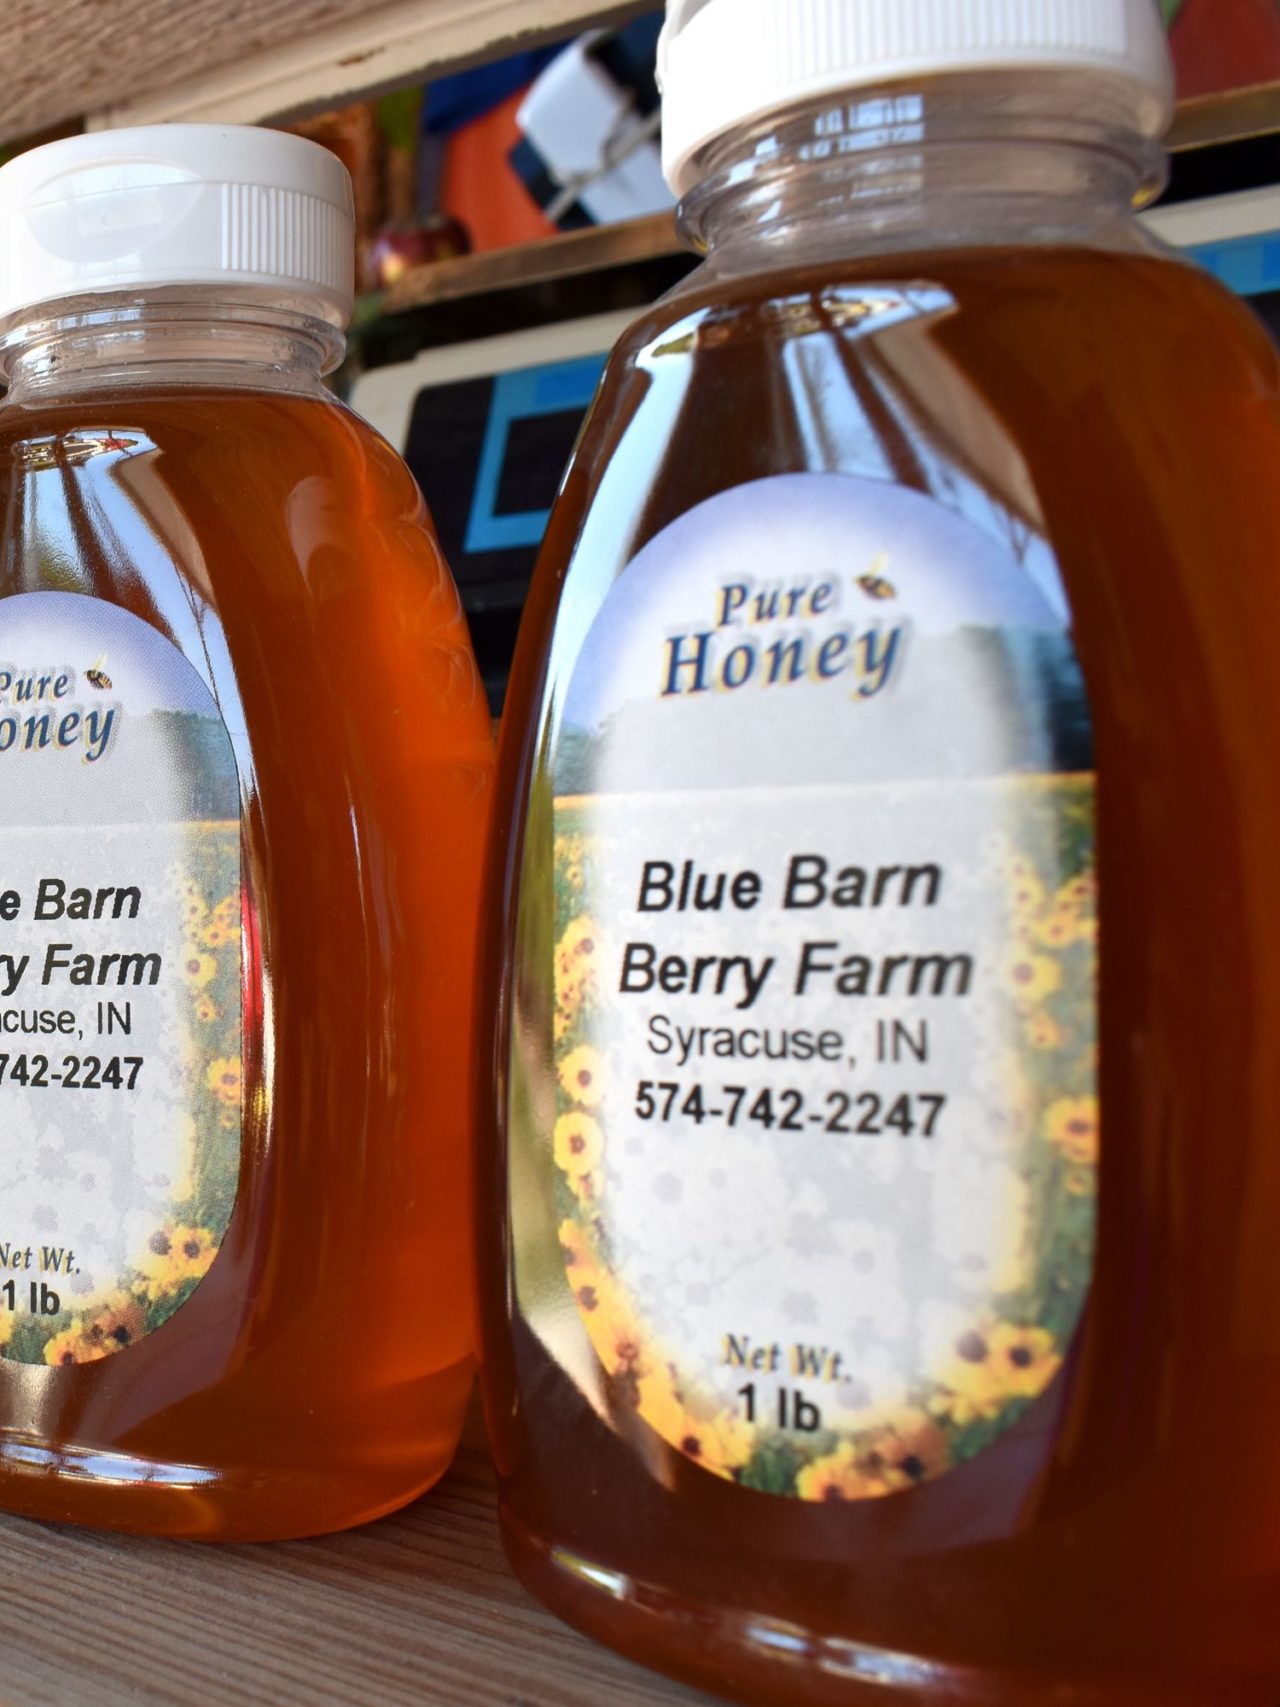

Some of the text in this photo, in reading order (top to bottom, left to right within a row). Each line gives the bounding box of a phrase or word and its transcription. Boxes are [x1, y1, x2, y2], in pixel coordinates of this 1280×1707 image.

[715, 580, 834, 630] Pure
[658, 624, 904, 700] Honey
[33, 878, 142, 920] Barn
[637, 854, 941, 912] Blue Barn
[41, 943, 162, 986] Farm
[618, 941, 973, 1010] Berry Farm
[97, 1001, 132, 1036] IN
[647, 1014, 928, 1070] Syracuse, IN
[635, 1080, 947, 1138] 574-742-2247
[38, 1246, 81, 1276] Wt.
[2, 1279, 61, 1316] 1 lb
[721, 1333, 853, 1383] Net Wt.
[738, 1382, 820, 1432] 1 lb
